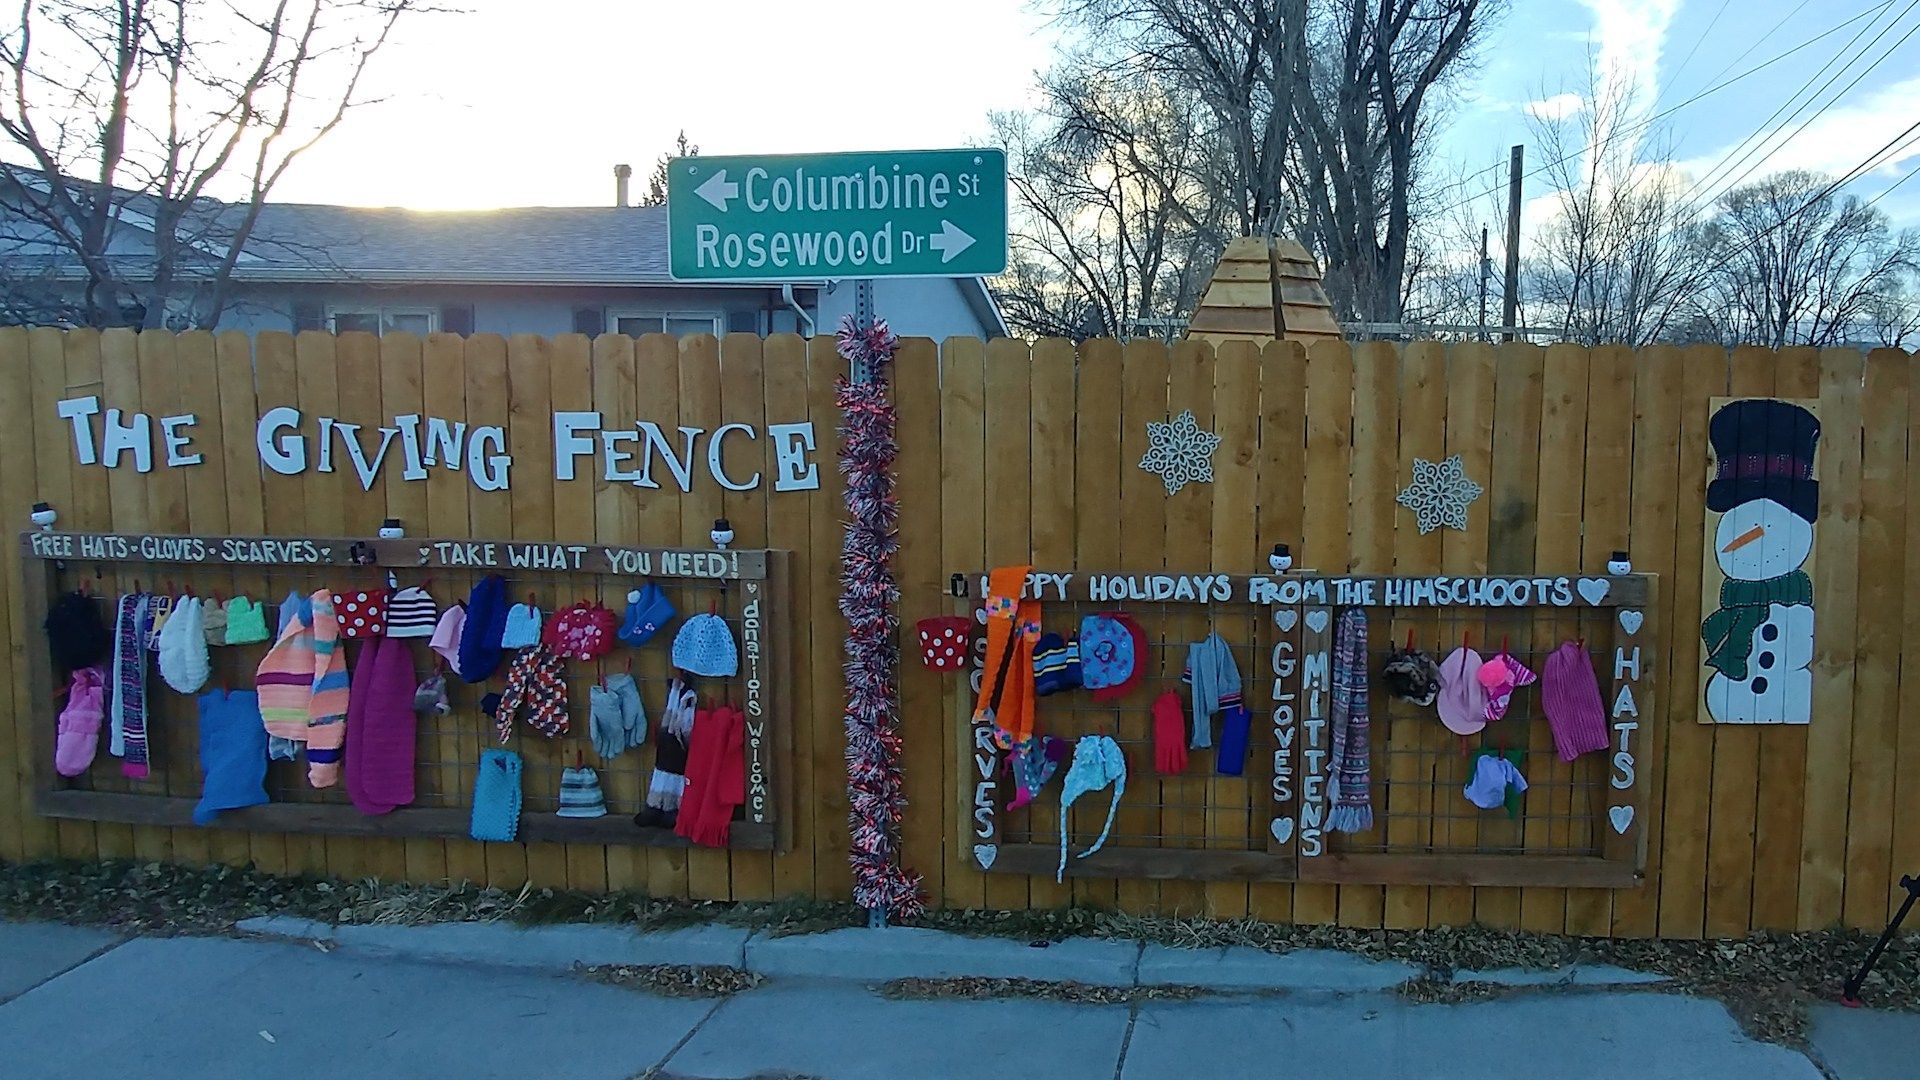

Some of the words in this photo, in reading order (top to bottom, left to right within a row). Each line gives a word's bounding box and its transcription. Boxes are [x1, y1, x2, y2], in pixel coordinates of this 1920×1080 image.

[745, 164, 951, 213] Columbine
[957, 172, 980, 196] St
[696, 220, 893, 269] Rosewood
[902, 230, 924, 254] Dr
[57, 396, 202, 473] THE
[256, 406, 512, 492] GIVING
[554, 411, 820, 493] FENCE
[30, 532, 72, 557] FREE
[80, 535, 128, 559] HATS
[140, 536, 206, 562] GLOVES
[221, 539, 319, 564] SCARVES
[434, 542, 498, 568] TAKE
[508, 545, 588, 571] WHAT
[605, 548, 652, 575] YOU
[662, 550, 740, 580] NEED!
[981, 573, 1074, 602] PPY
[1089, 574, 1232, 603] HOLIDAYS
[1248, 576, 1327, 606] FROM
[1330, 577, 1377, 606] THE
[1385, 576, 1574, 607] HIMSCHOOTS
[1272, 641, 1297, 802] GLOVES
[1300, 651, 1329, 858] MITTENS
[1611, 646, 1640, 790] HATS
